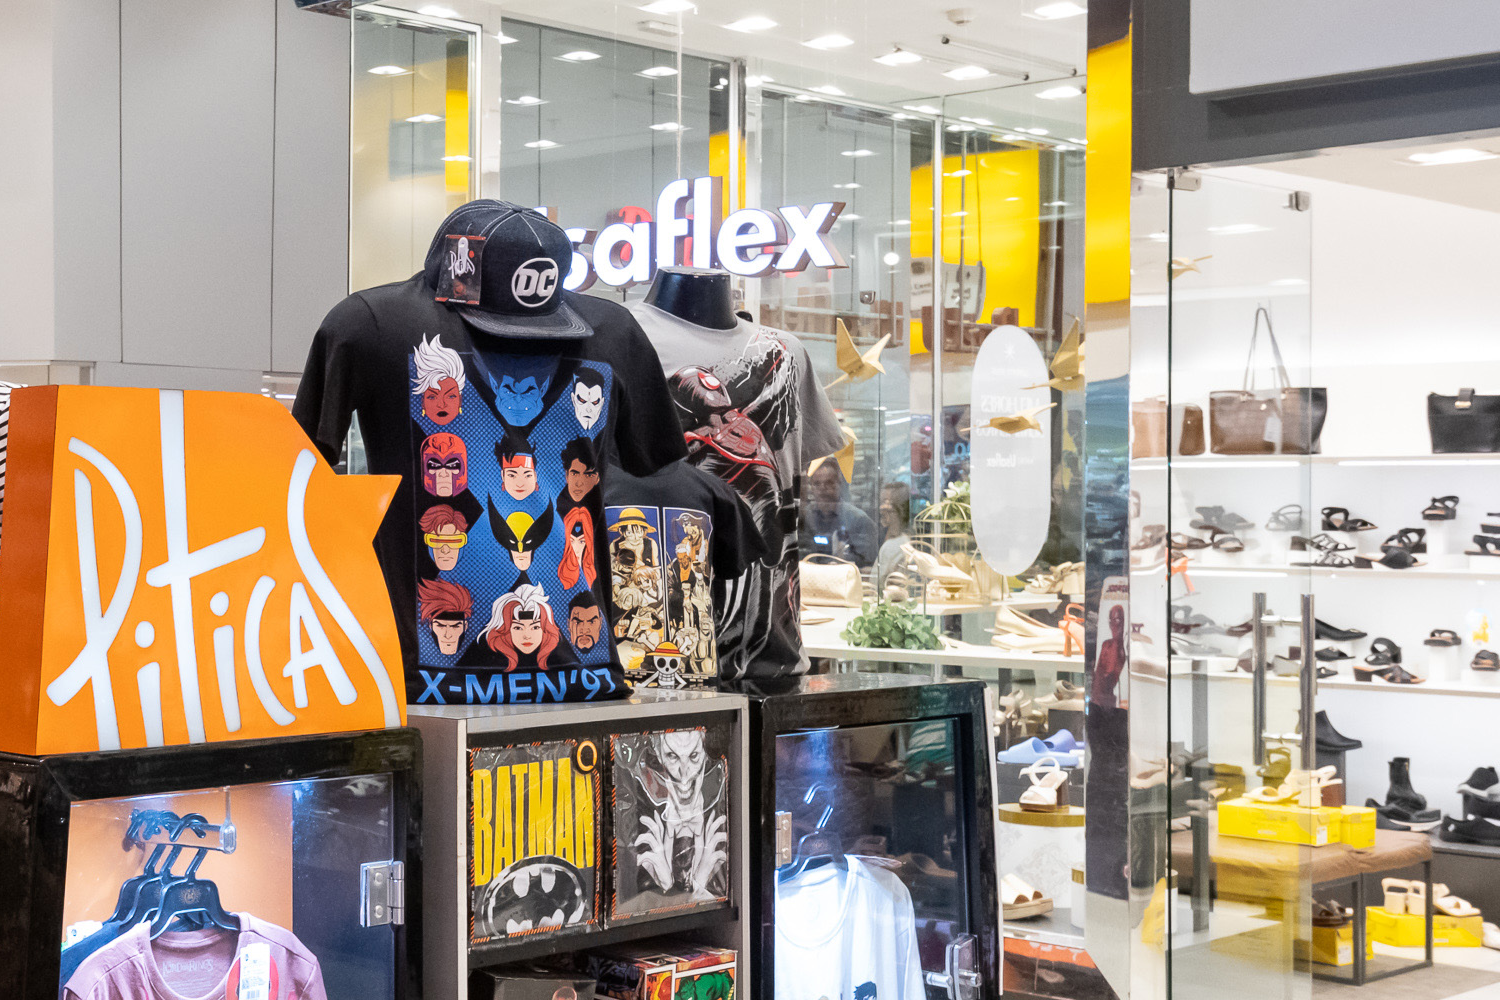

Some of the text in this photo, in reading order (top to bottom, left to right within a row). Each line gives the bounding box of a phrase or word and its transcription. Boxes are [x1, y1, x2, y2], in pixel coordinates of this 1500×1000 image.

[515, 268, 556, 297] DC
[558, 177, 837, 292] saflex
[474, 757, 594, 886] BATMAN
